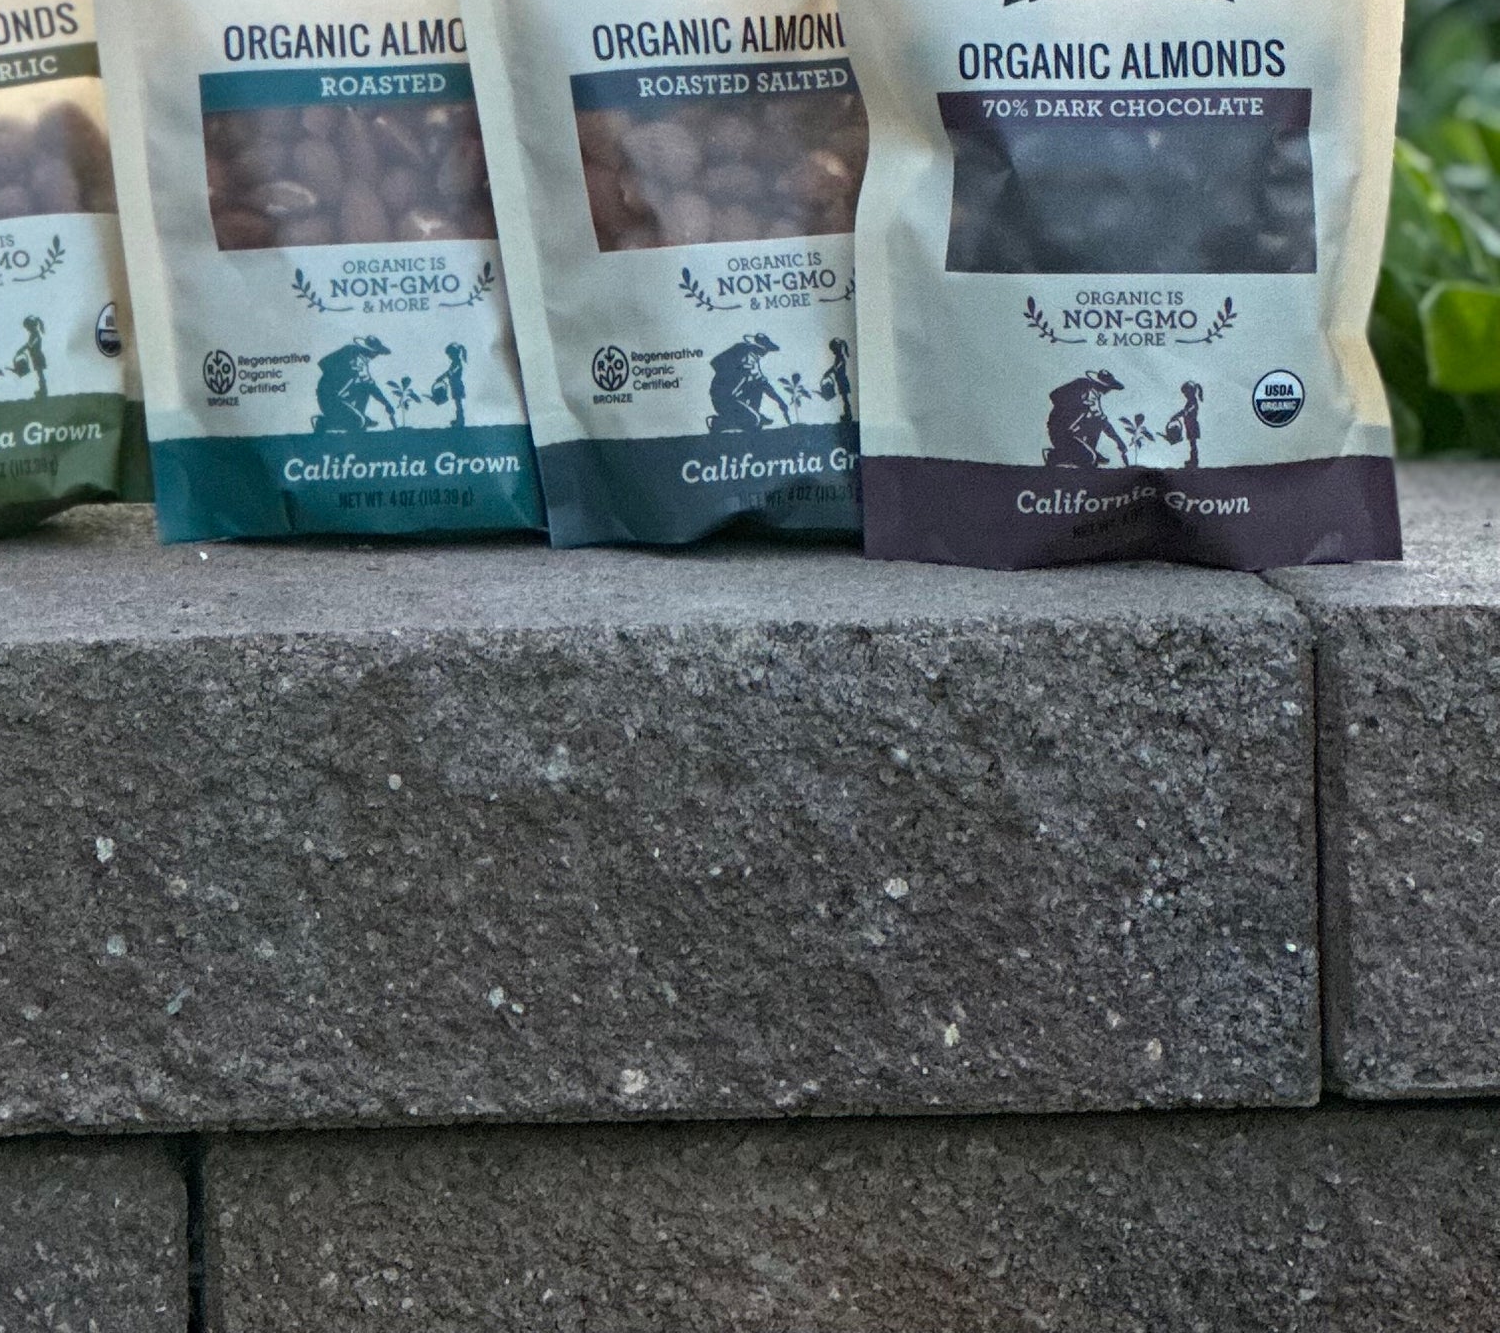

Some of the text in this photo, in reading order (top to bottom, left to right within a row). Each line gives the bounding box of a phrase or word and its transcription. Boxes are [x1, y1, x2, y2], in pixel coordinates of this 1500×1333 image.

[223, 23, 370, 62] ORGANIC
[592, 12, 846, 61] ORGANIC ALMON
[958, 38, 1286, 81] ORGANIC ALMONDS
[320, 72, 446, 98] ROASTED
[638, 68, 848, 98] ROASTED SALTED
[982, 97, 1263, 119] 70% DARK CHOCOLATE
[342, 257, 446, 275] ORGANIC IS
[728, 252, 822, 272] ORGANIC IS
[330, 274, 460, 298] NON-GMO
[717, 269, 836, 297] NON-GMO
[379, 298, 430, 312] MORE
[765, 293, 811, 309] MORE
[1075, 291, 1183, 307] ORGANIC IS
[1062, 310, 1198, 330] NON-GMO
[1113, 332, 1166, 346] MORE
[631, 363, 674, 378] Organic
[593, 393, 633, 405] BRONZE
[1265, 384, 1294, 397] USDA
[22, 421, 102, 445] Grown
[284, 452, 520, 482] California Grown
[682, 453, 824, 484] California
[1017, 487, 1250, 515] California Grown
